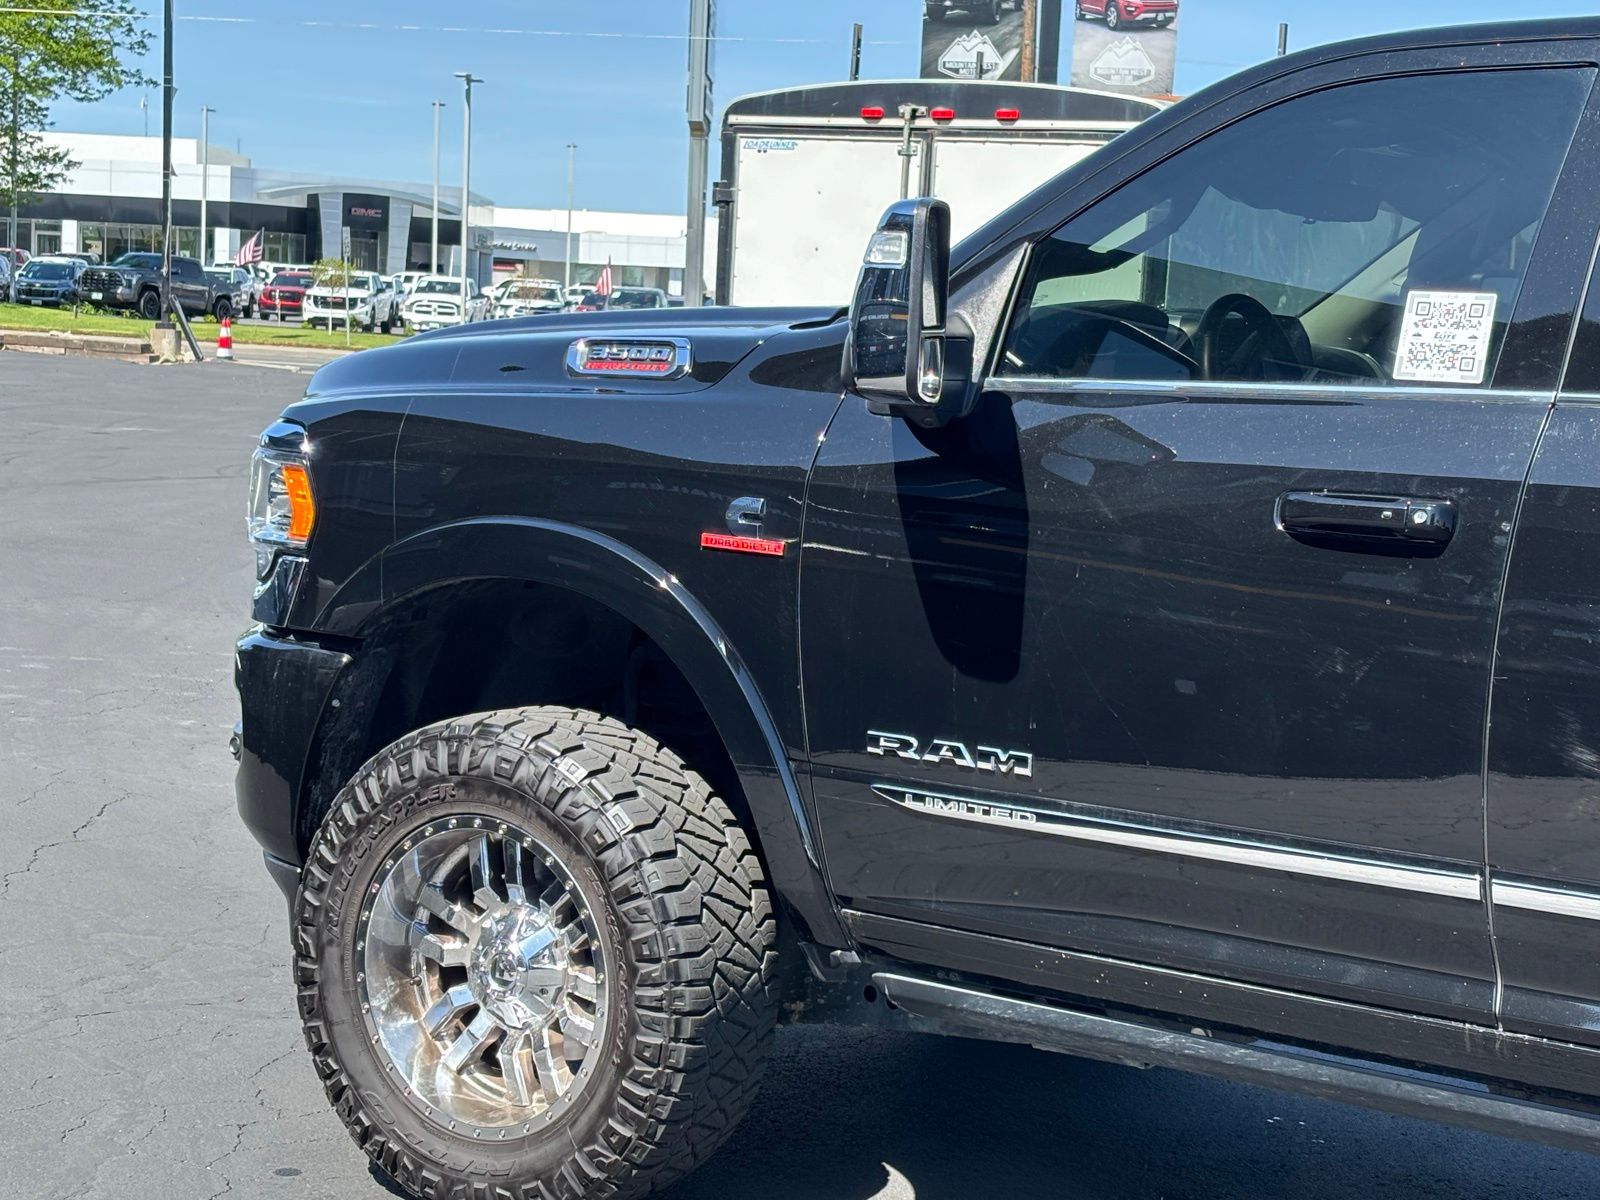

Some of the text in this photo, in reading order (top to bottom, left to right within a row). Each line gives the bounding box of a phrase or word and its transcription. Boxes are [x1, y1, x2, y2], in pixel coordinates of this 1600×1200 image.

[351, 207, 382, 218] GMC
[588, 346, 671, 361] 3500
[705, 536, 782, 554] TURBO DIESEL
[867, 730, 1033, 778] RAM
[904, 793, 1037, 824] LIMITED
